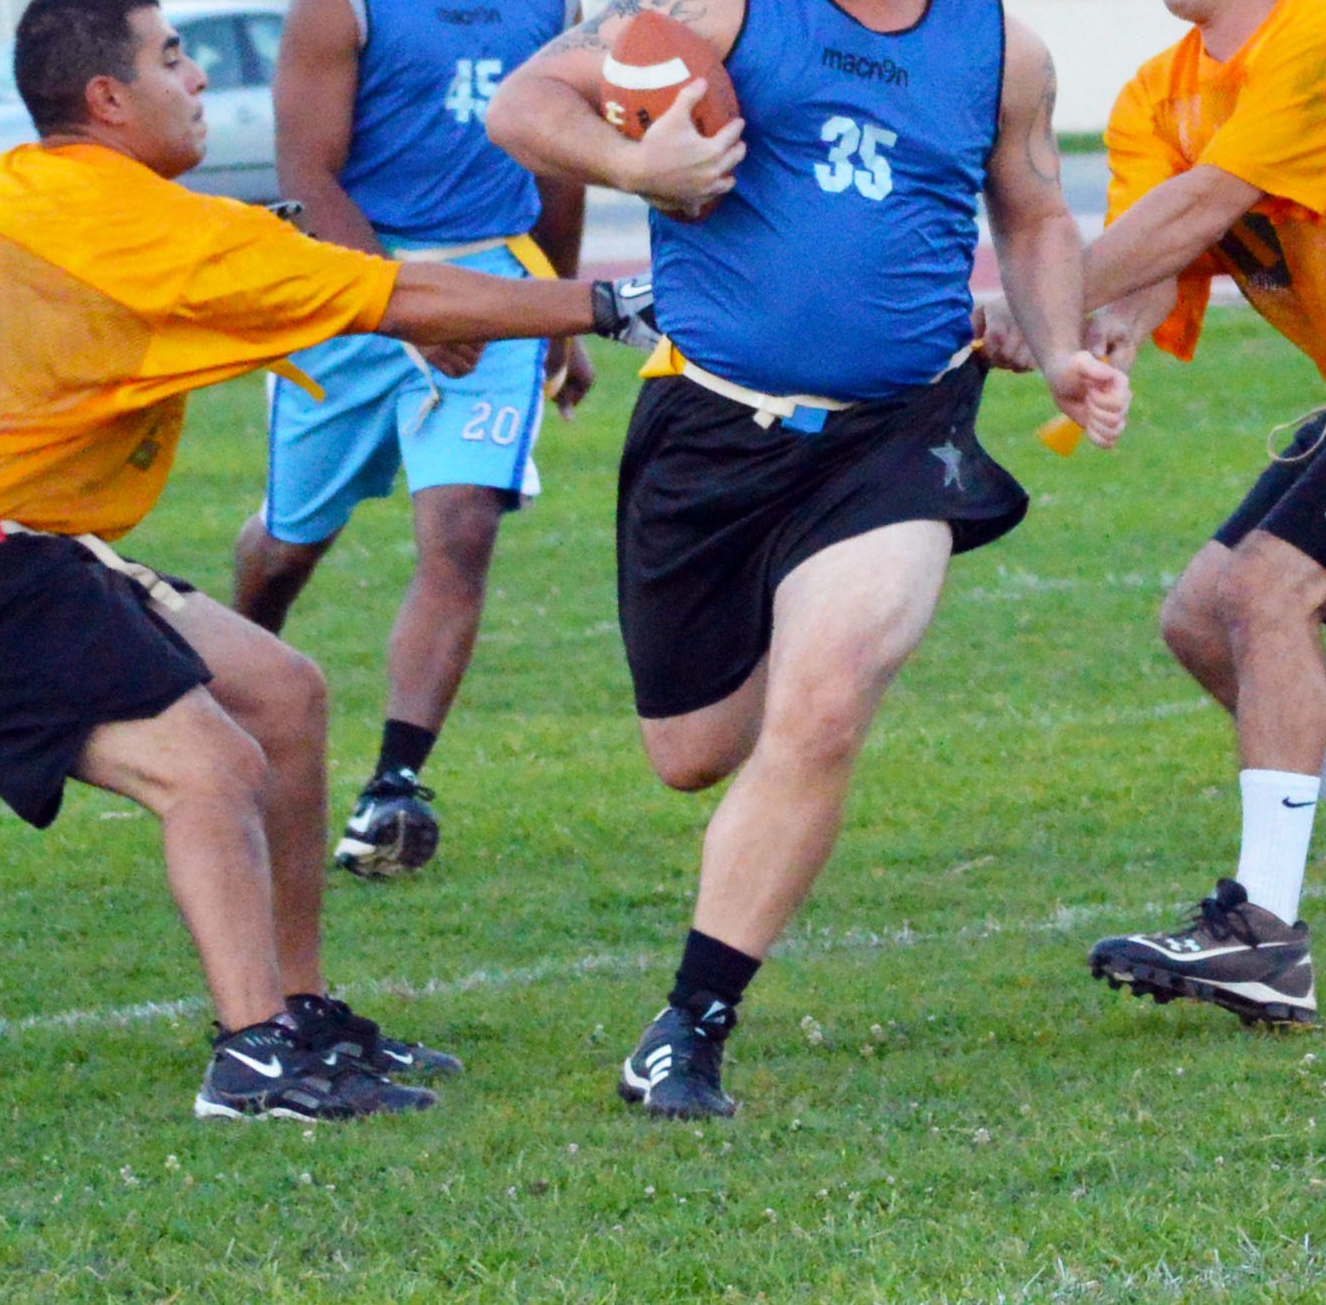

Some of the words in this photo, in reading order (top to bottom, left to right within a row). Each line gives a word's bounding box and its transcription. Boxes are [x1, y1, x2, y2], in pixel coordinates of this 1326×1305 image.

[444, 59, 502, 124] 45
[813, 115, 898, 201] 35
[462, 402, 520, 445] 20
